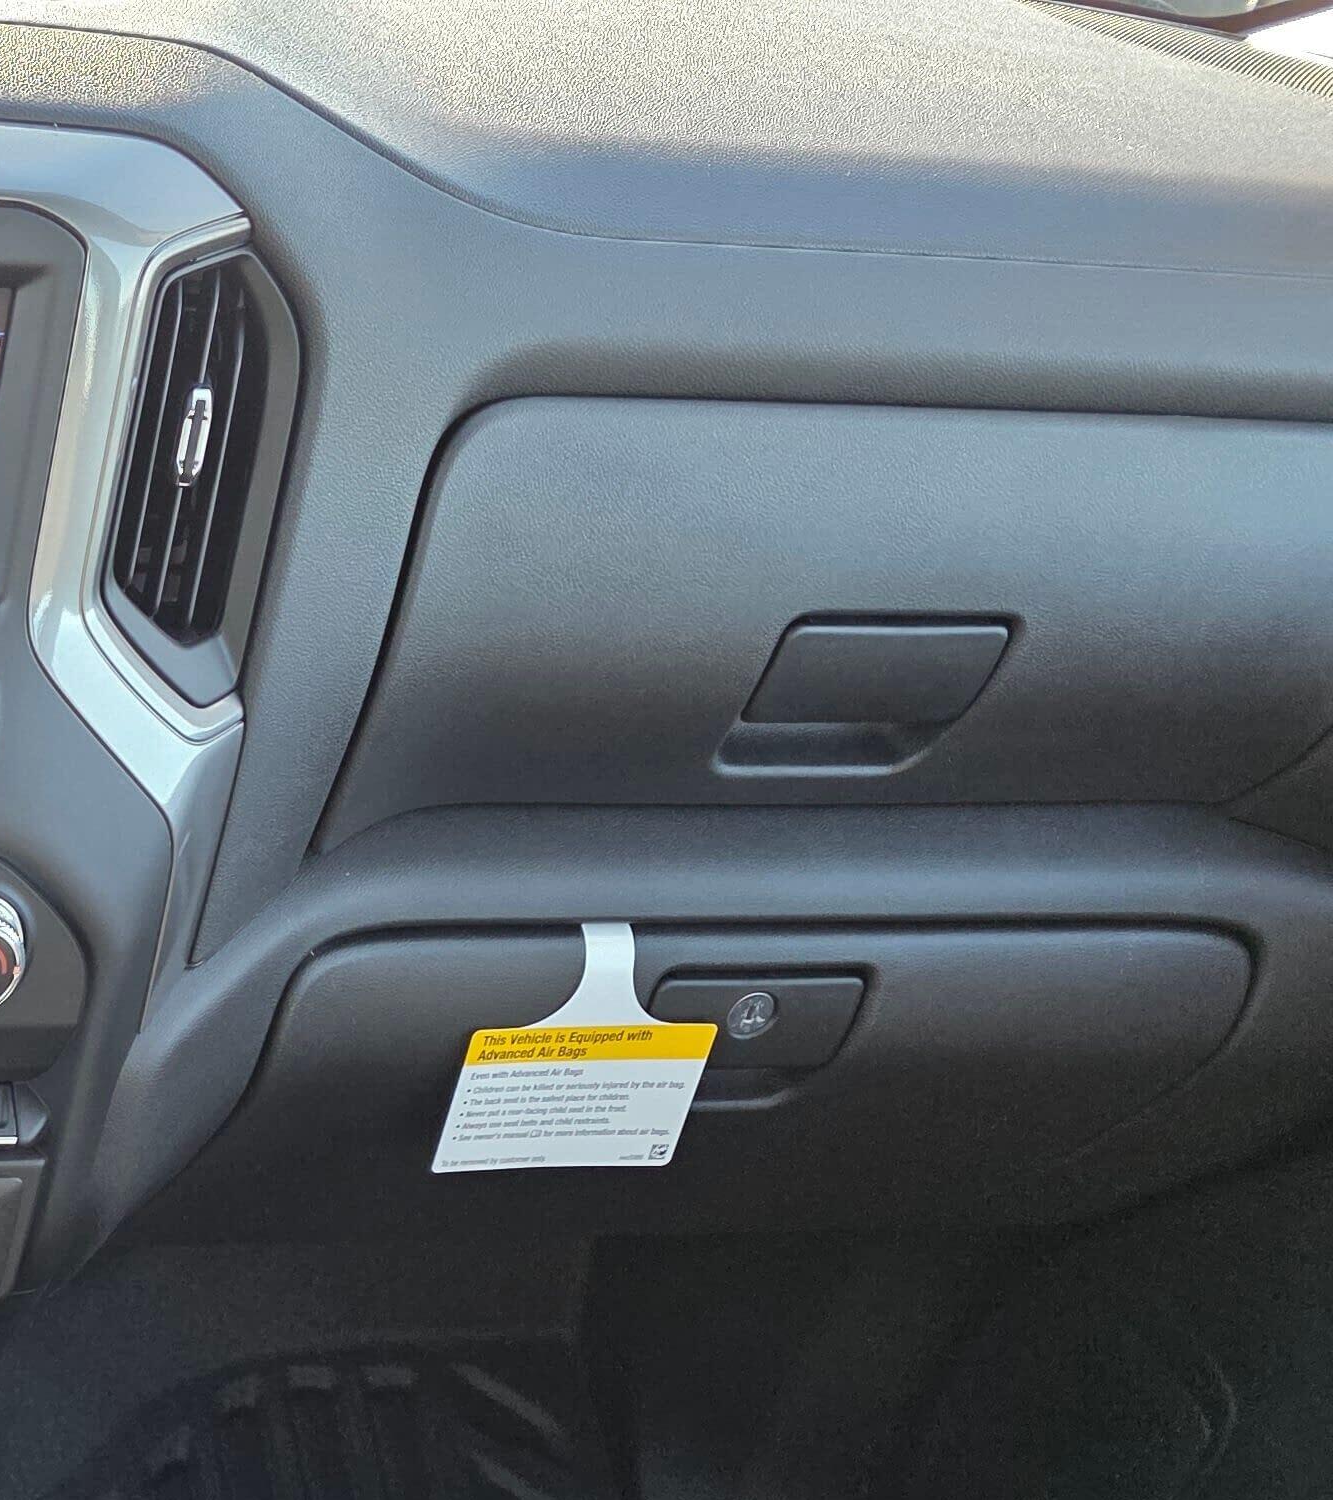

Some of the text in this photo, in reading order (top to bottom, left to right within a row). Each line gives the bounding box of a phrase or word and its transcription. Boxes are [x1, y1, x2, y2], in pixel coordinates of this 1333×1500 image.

[483, 1030, 653, 1046] This Vehicle is Equipped with
[477, 1046, 587, 1061] Advanced Air Bags
